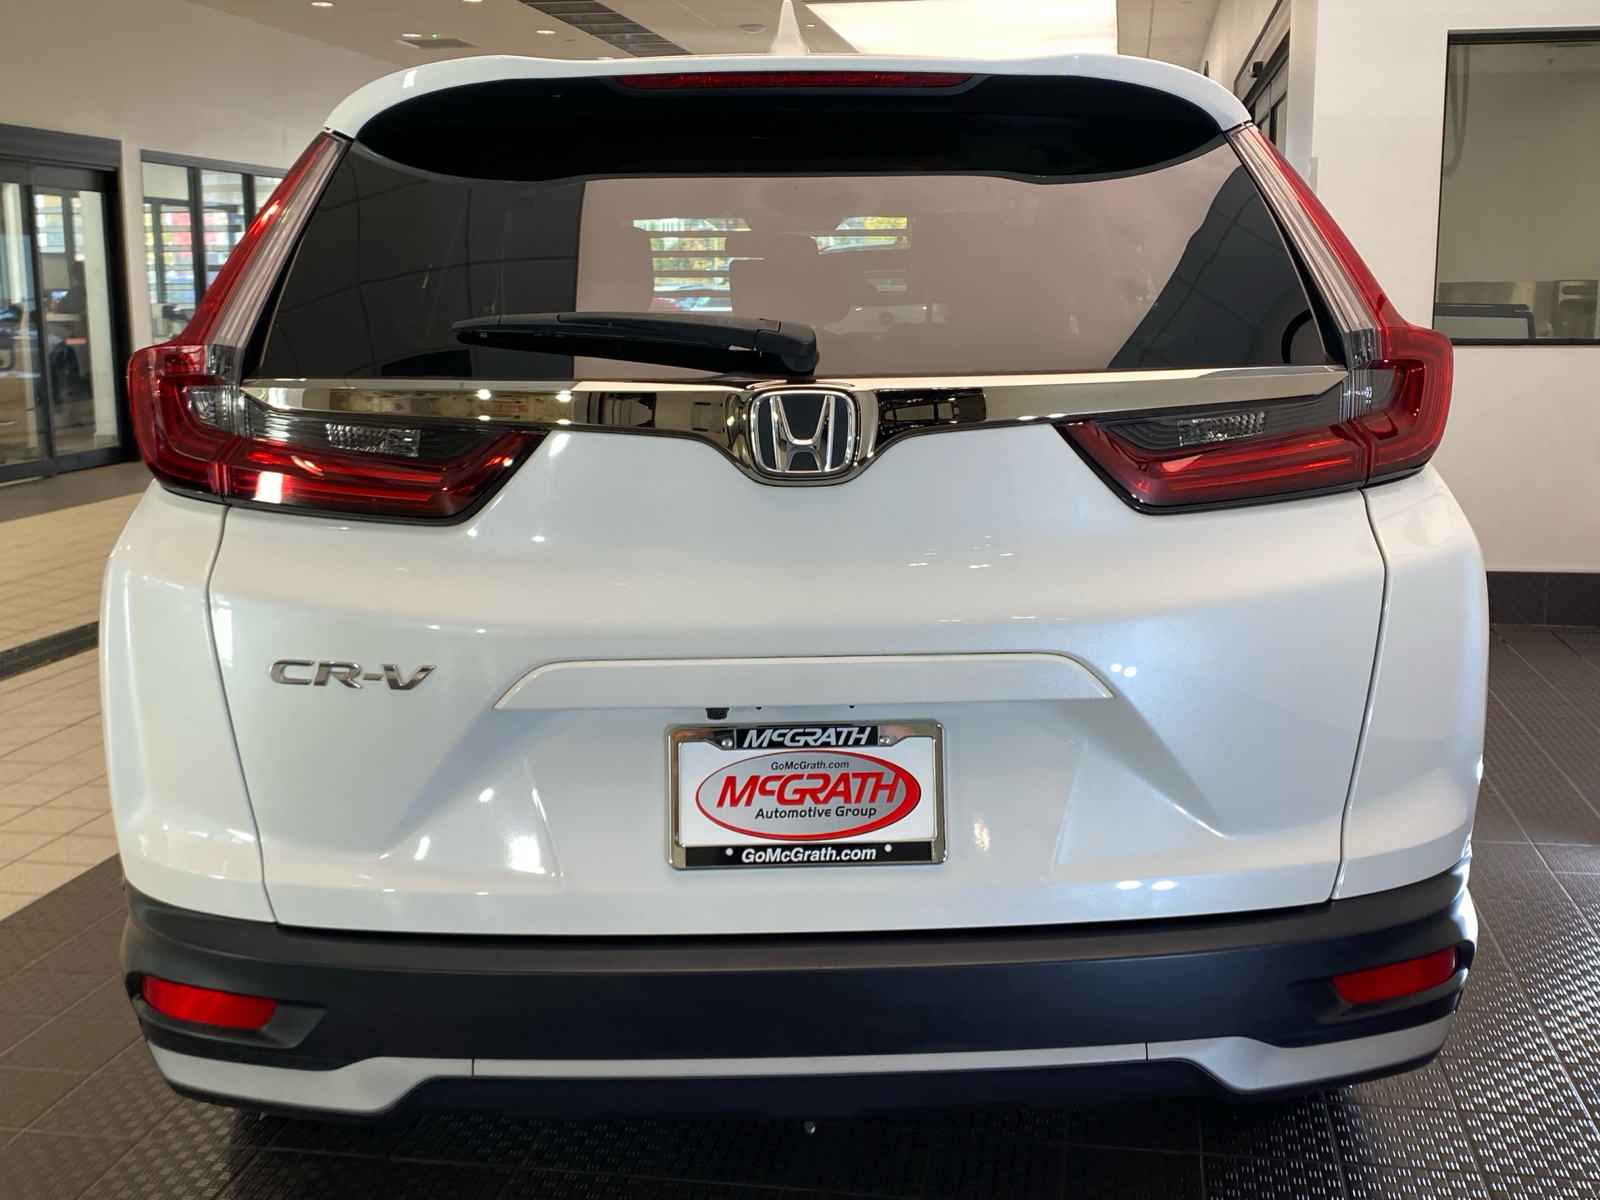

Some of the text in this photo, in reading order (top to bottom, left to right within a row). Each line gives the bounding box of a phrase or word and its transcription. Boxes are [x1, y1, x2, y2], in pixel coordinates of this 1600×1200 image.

[269, 659, 436, 690] CR-V
[770, 760, 850, 771] GoMcGrath.com
[754, 805, 878, 819] Automotive Group
[741, 846, 877, 864] GoMcGrath.com
